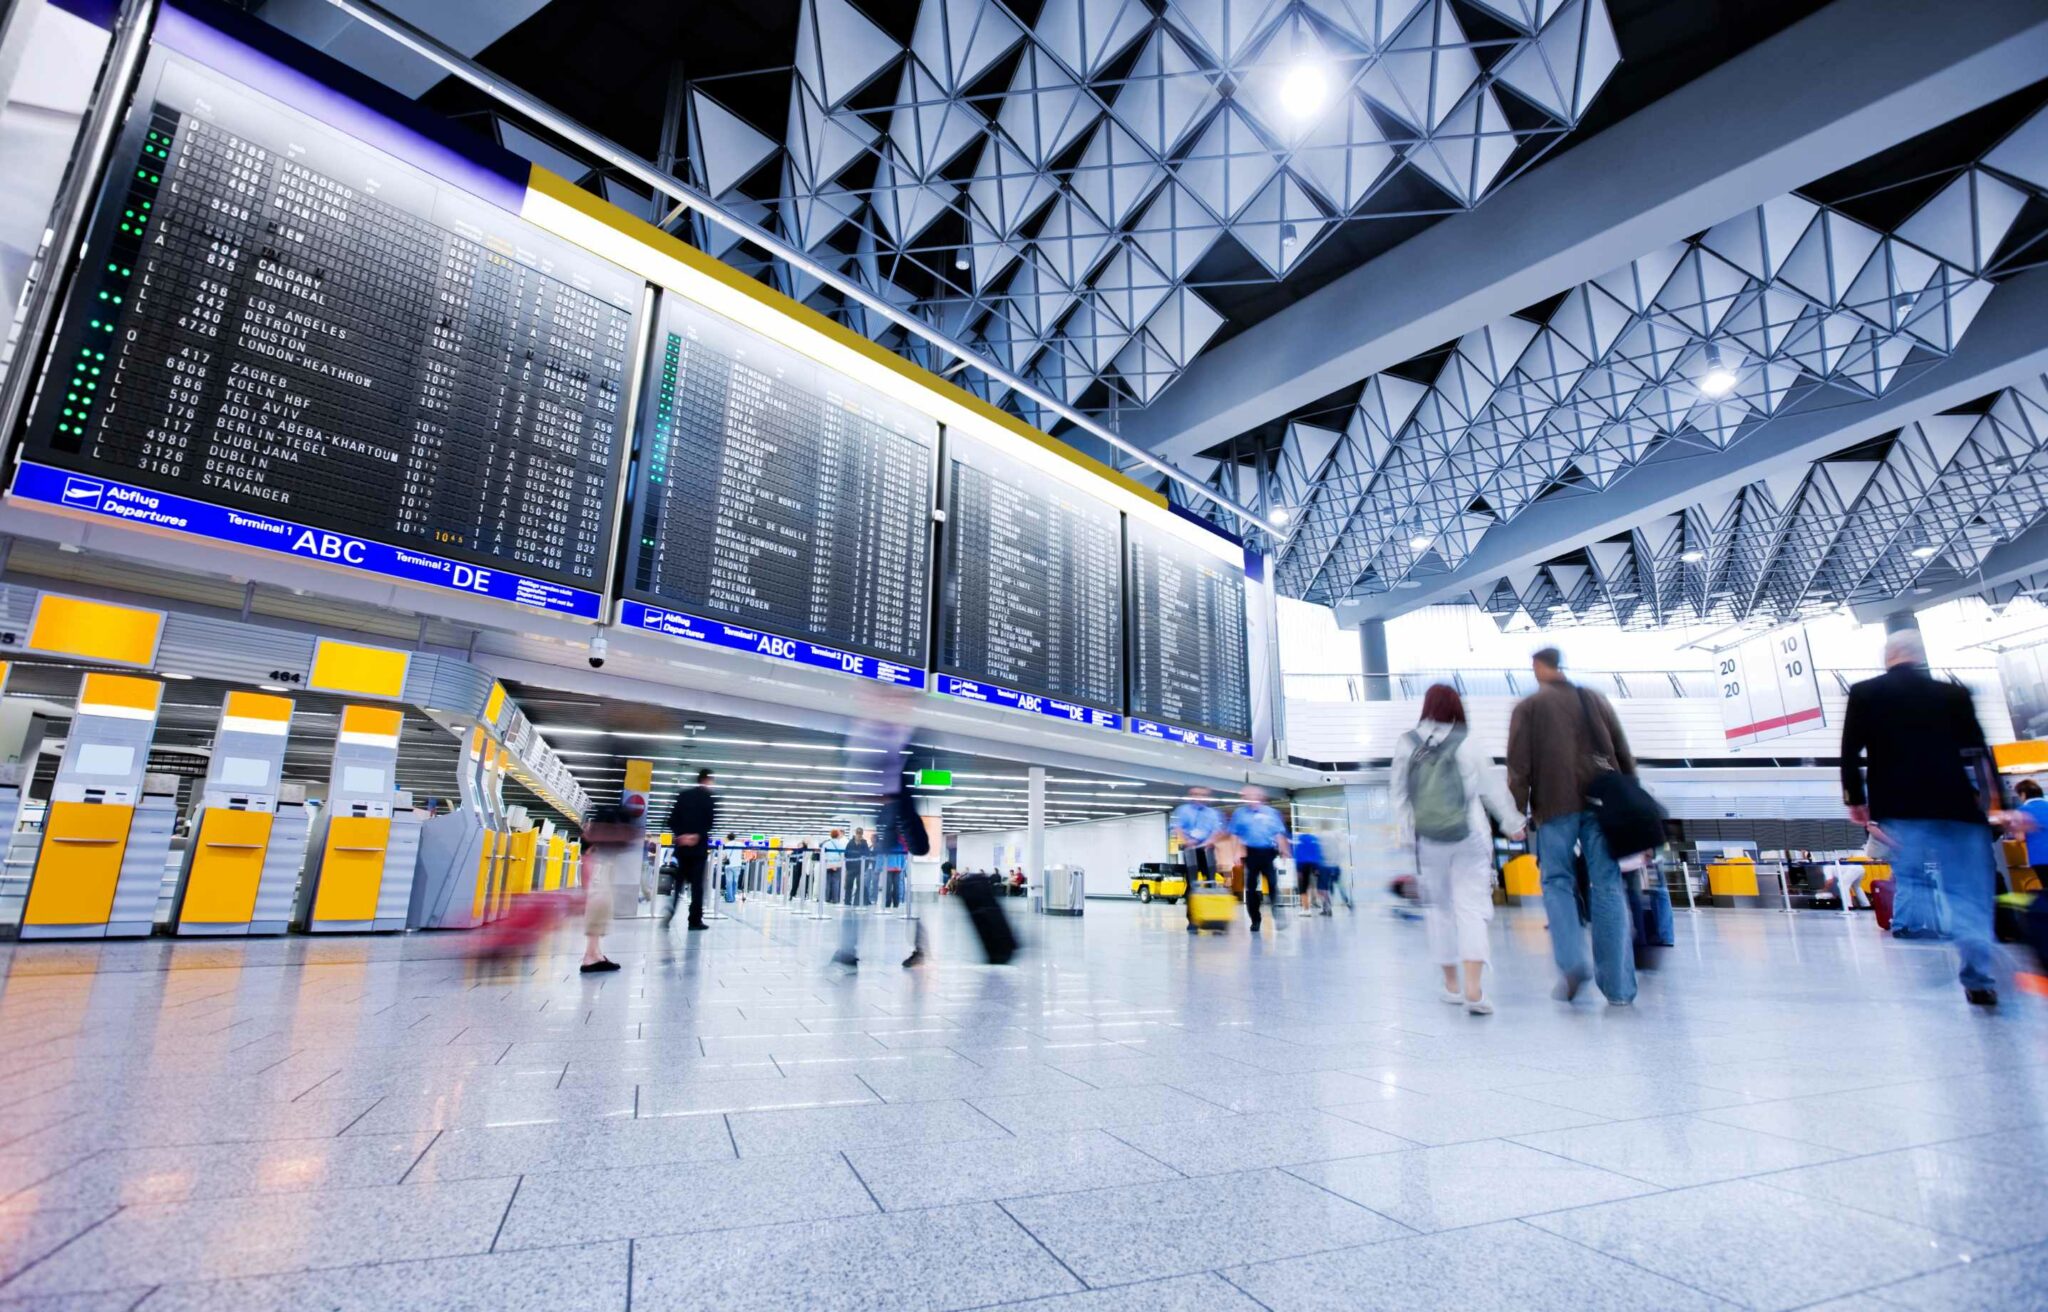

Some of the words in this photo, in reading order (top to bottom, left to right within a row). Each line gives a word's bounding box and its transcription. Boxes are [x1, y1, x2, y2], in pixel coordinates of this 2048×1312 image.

[225, 149, 263, 173] 3102
[280, 173, 347, 210] HELSINKI
[228, 137, 266, 161] 2188
[283, 162, 352, 199] VARADERO
[228, 178, 256, 197] 462
[274, 197, 316, 222] MIAMI
[277, 185, 346, 222] PORTLAND
[211, 199, 250, 222] 3236
[267, 221, 304, 243] IEW
[206, 253, 236, 272] 875
[254, 271, 326, 305] MONTREAL
[210, 240, 239, 259] 494
[257, 258, 321, 290] CALGARY
[191, 306, 222, 324] 440
[240, 322, 306, 352] HOUSTON
[195, 292, 225, 311] 442
[244, 309, 309, 340] DETROIT
[199, 279, 229, 298] 456
[247, 296, 276, 314] LOS
[284, 310, 346, 339] ANGELES
[177, 315, 218, 337] 4726
[237, 335, 371, 388] LONDON-HEATHROW
[180, 346, 211, 364] 417
[230, 362, 287, 388] ZAGREB
[166, 356, 207, 378] 6808
[226, 375, 275, 398] KOELN
[283, 393, 311, 409] HBF
[172, 374, 204, 391] 686
[222, 389, 253, 406] TEL
[261, 400, 299, 420] AVIV
[162, 416, 192, 433] 117
[212, 430, 298, 462] LJUBLJANA
[166, 402, 196, 419] 176
[215, 416, 328, 456] BERLIN-TEGEL
[168, 388, 200, 405] 590
[219, 402, 268, 425] ADDIS
[276, 419, 398, 462] ABEBA-KHARTOUM
[141, 442, 184, 462] 3126
[204, 458, 264, 482] BERGEN
[145, 427, 188, 448] 4980
[208, 444, 267, 468] DUBLIN
[107, 486, 159, 508] Abflug
[137, 456, 181, 476] 3160
[200, 472, 289, 503] STAVANGER
[720, 486, 754, 504] CHICAGO
[103, 500, 188, 527] Departures
[719, 496, 753, 514] DETROIT
[227, 512, 284, 535] Terminal
[286, 526, 293, 536] 1
[292, 530, 366, 564] ABC
[395, 551, 442, 570] Terminal
[443, 562, 451, 572] 2
[452, 565, 492, 592] DE
[713, 557, 747, 573] TORONTO
[714, 546, 748, 563] VILNIUS
[715, 536, 759, 556] NUERNBERG
[712, 567, 750, 584] HELSINKI
[708, 598, 738, 613] DUBLIN
[709, 588, 768, 610] POZNAN/POSEN
[663, 623, 705, 639] Departures
[664, 613, 691, 627] Abflug
[723, 626, 753, 641] Terminal
[757, 635, 796, 659] ABC
[810, 646, 836, 659] Terminal
[842, 653, 864, 674] DE
[1780, 636, 1797, 654] 10
[269, 670, 300, 683] 464
[1720, 658, 1736, 675] 20
[1785, 660, 1802, 678] 10
[1018, 694, 1042, 714] ABC
[1069, 705, 1084, 721] DE
[1724, 681, 1740, 698] 20
[1182, 731, 1199, 745] ABC
[1216, 739, 1227, 750] DE
